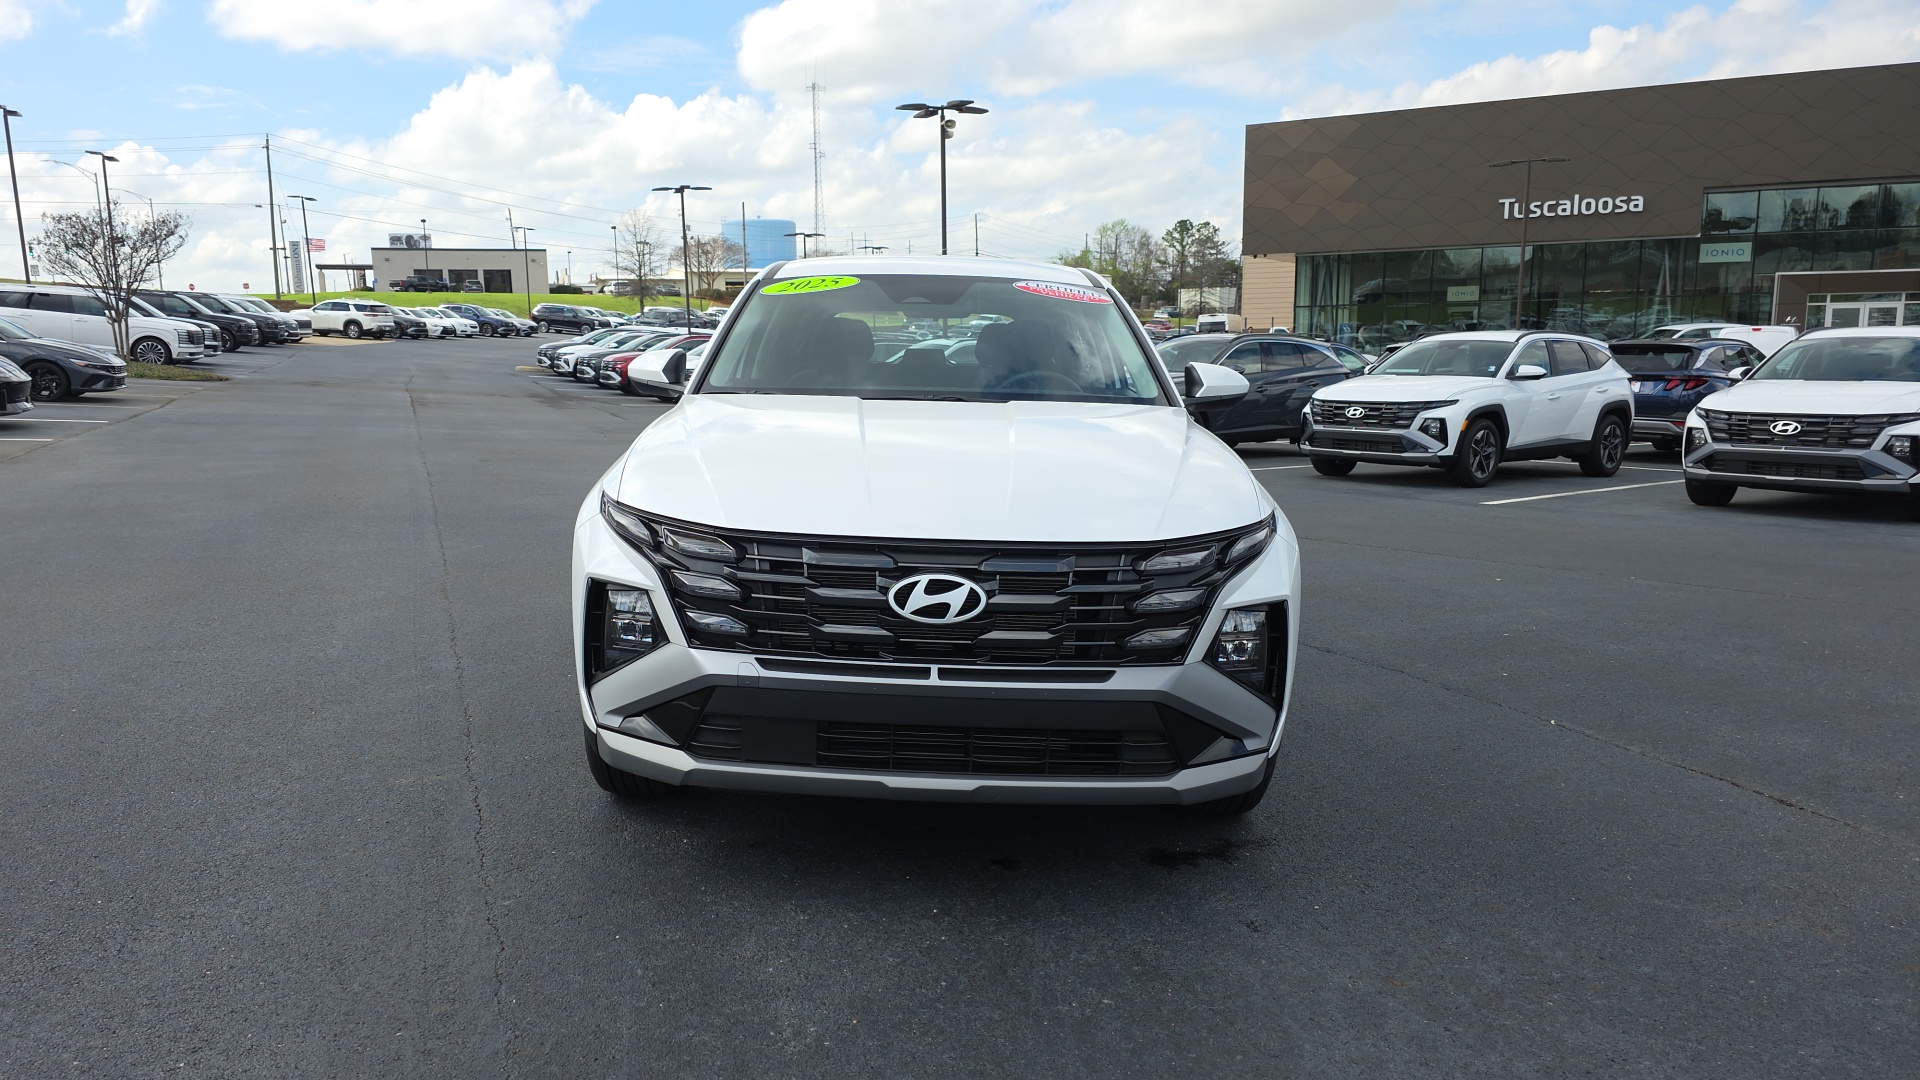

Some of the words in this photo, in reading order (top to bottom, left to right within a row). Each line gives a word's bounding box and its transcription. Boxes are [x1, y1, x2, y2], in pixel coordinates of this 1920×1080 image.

[1498, 193, 1644, 220] Tuscaloosa
[1705, 248, 1745, 257] IONIQ
[777, 277, 844, 293] 2025
[1025, 282, 1101, 298] CERTIFIED
